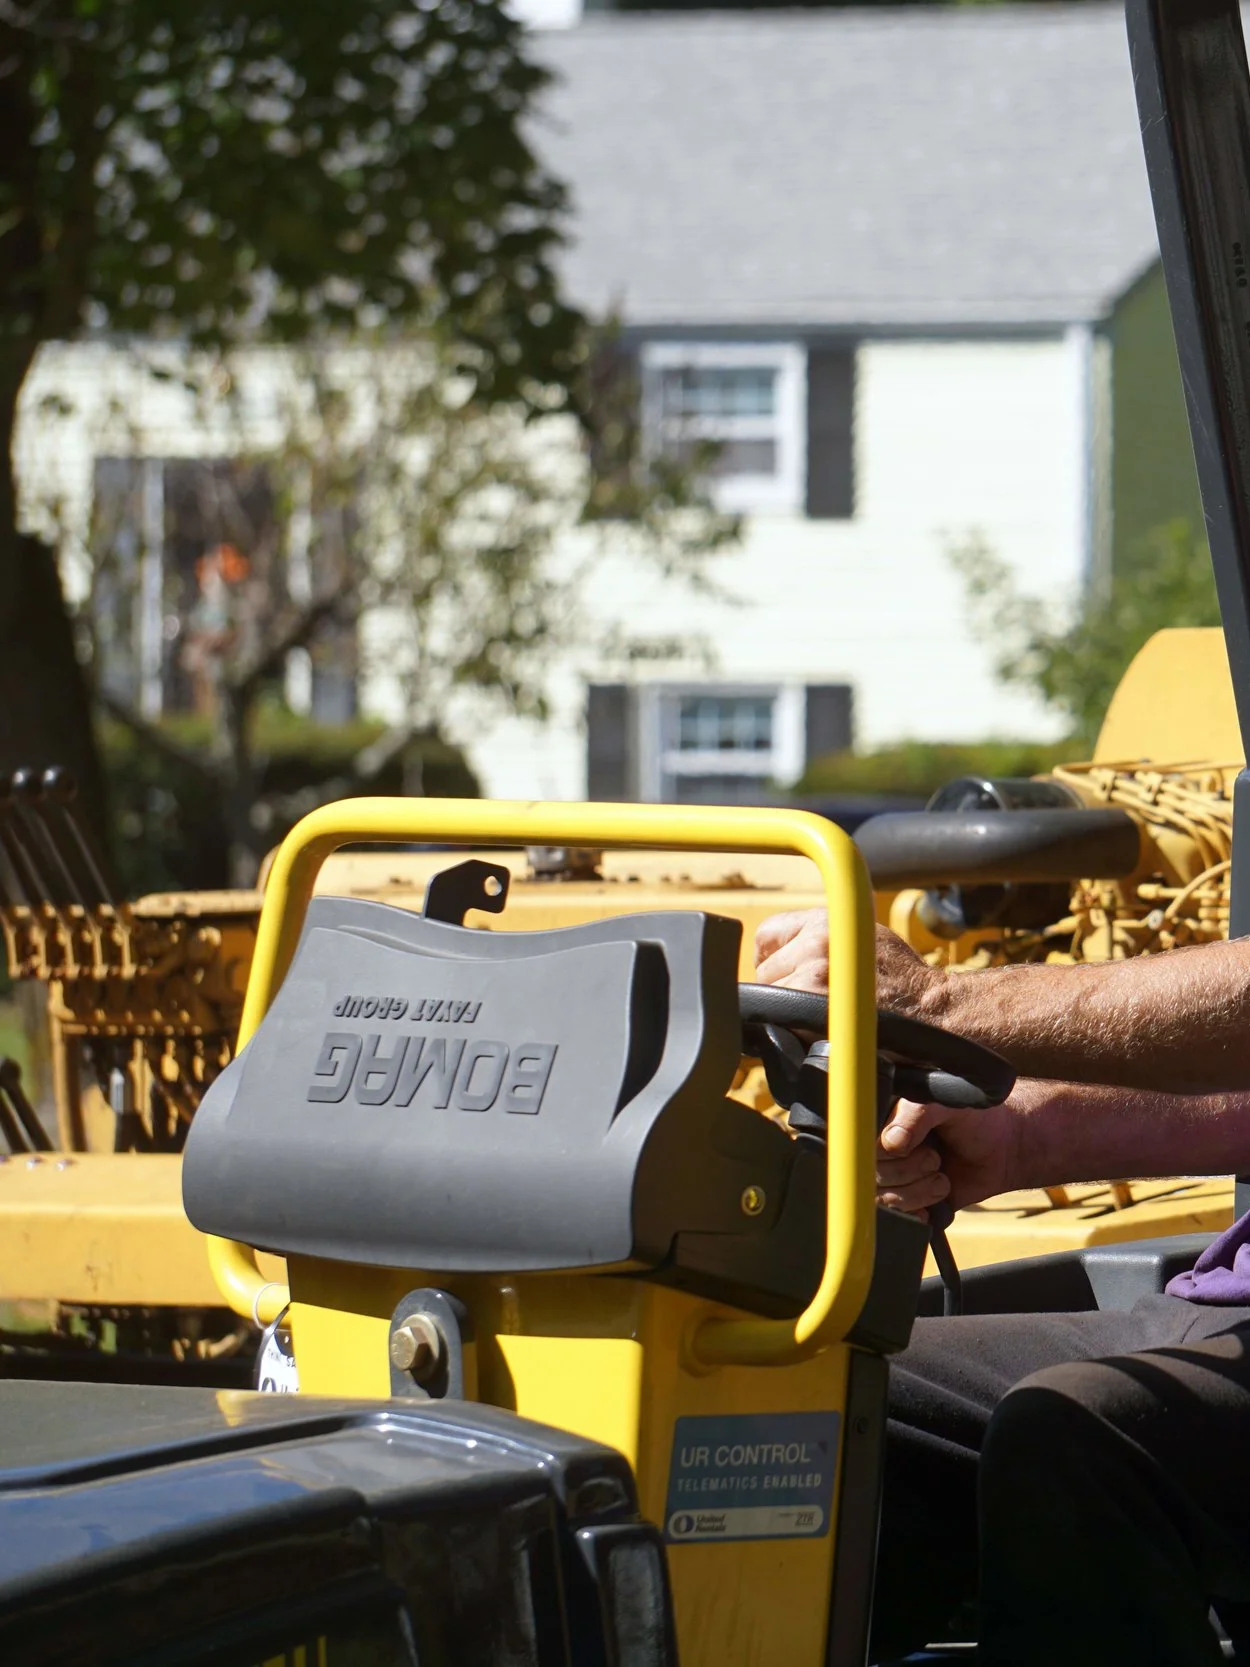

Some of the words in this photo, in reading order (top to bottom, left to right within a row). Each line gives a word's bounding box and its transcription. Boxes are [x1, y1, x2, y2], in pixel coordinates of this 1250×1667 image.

[333, 995, 409, 1020] GROUP
[410, 999, 482, 1023] FAYAT
[306, 1032, 559, 1115] BOMAG
[680, 1446, 709, 1468] UR
[715, 1443, 811, 1467] CONTROL
[677, 1475, 758, 1492] TELEMATICS
[763, 1473, 822, 1489] ENABLED
